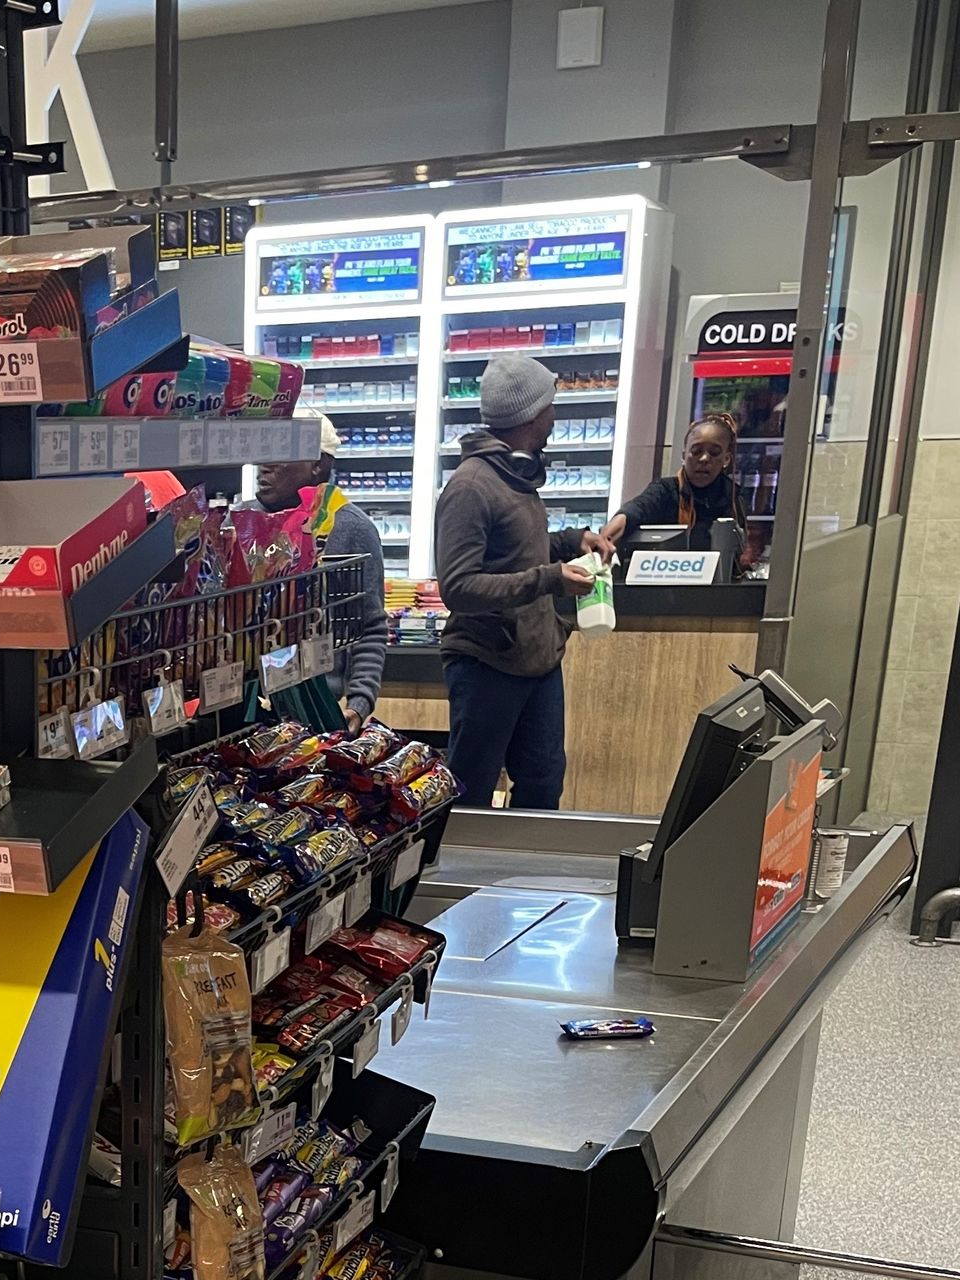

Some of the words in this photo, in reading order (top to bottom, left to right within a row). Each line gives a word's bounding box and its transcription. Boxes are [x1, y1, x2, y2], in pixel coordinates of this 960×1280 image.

[704, 323, 767, 345] COLD
[69, 529, 130, 588] Dentyne
[640, 555, 705, 572] closed
